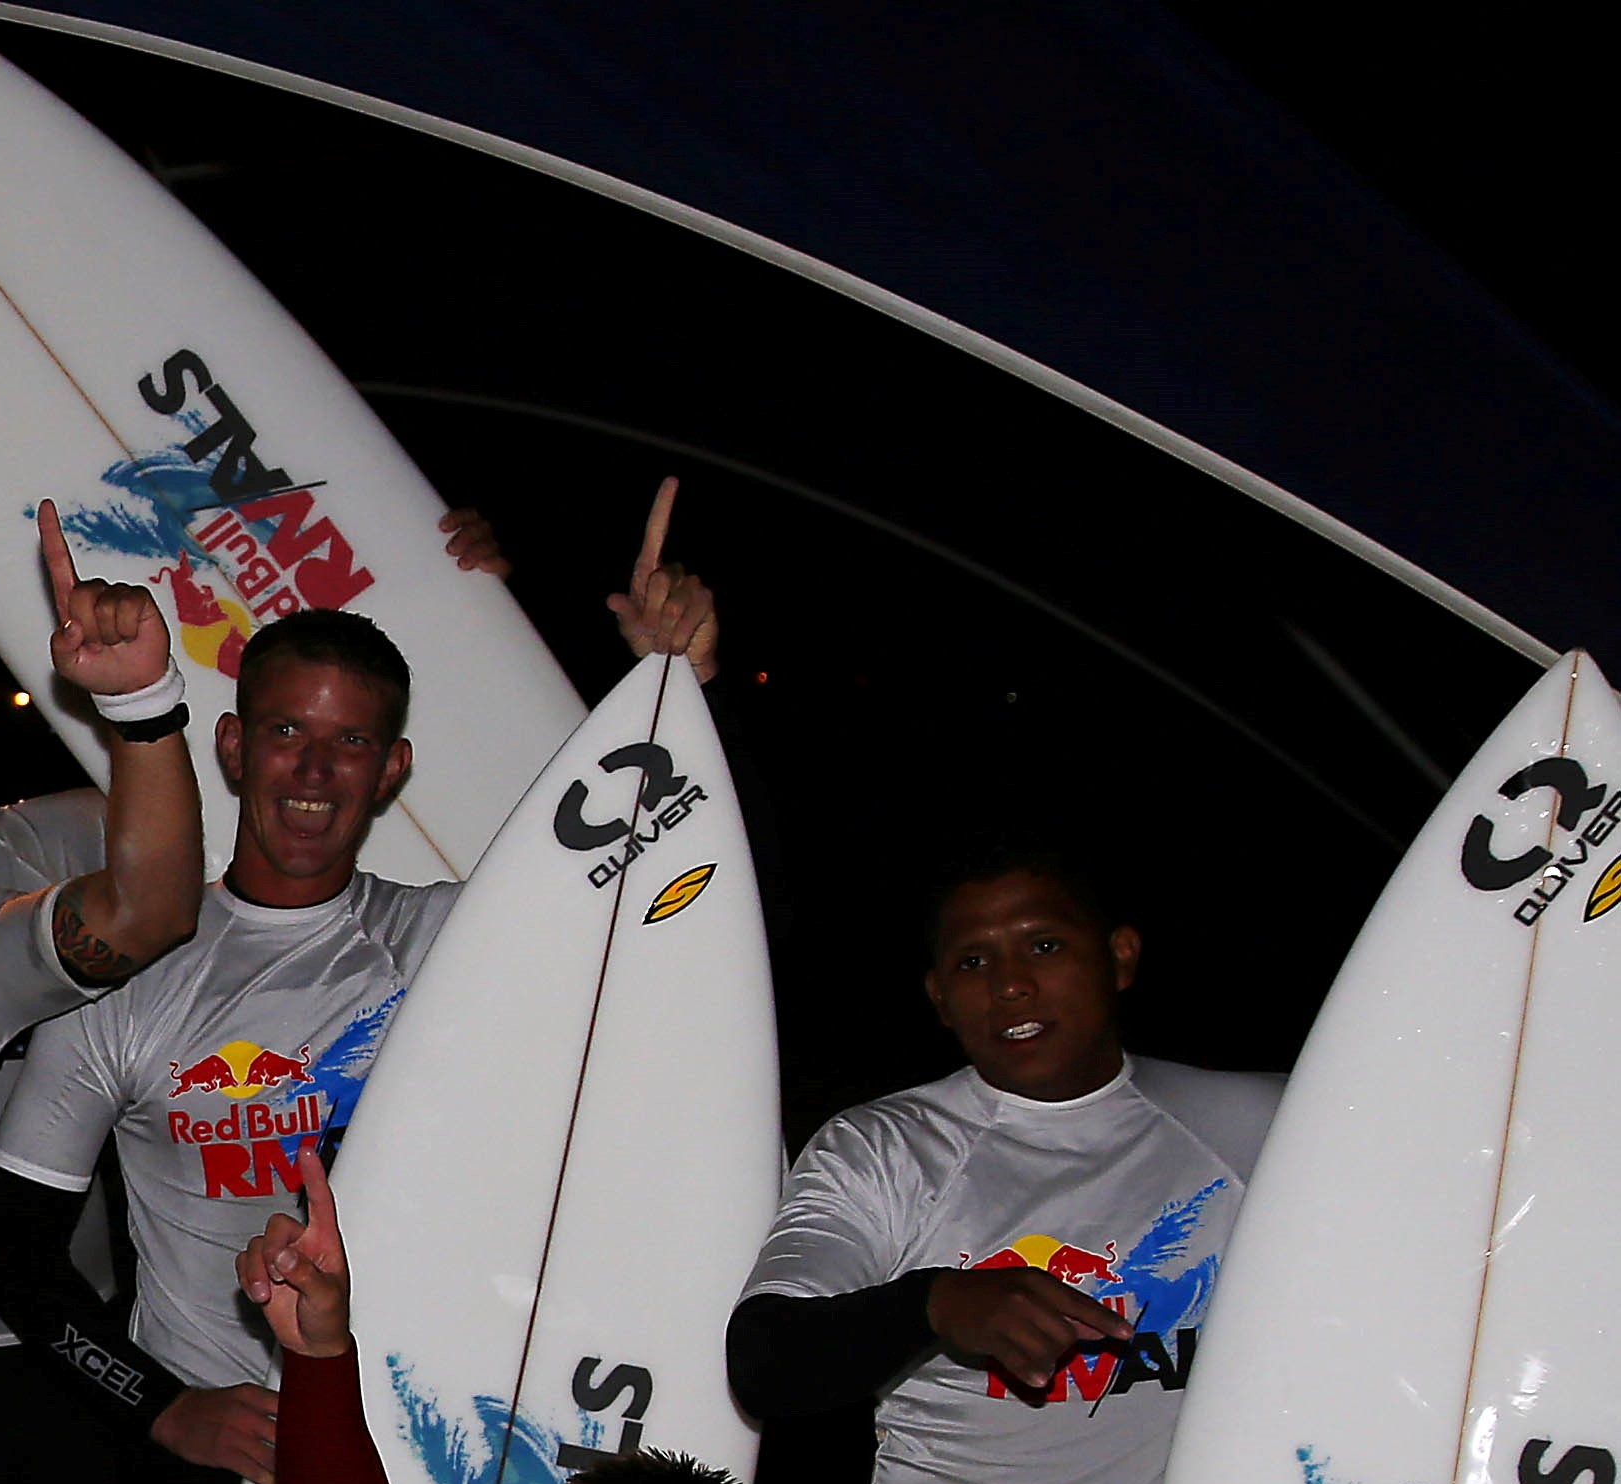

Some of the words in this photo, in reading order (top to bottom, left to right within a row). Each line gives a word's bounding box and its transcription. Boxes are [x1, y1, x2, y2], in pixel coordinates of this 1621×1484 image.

[195, 509, 281, 601] Bull
[587, 784, 709, 890] QUIVER
[167, 1108, 242, 1146] Red
[246, 1094, 321, 1140] Bull
[49, 1321, 146, 1407] XCEL
